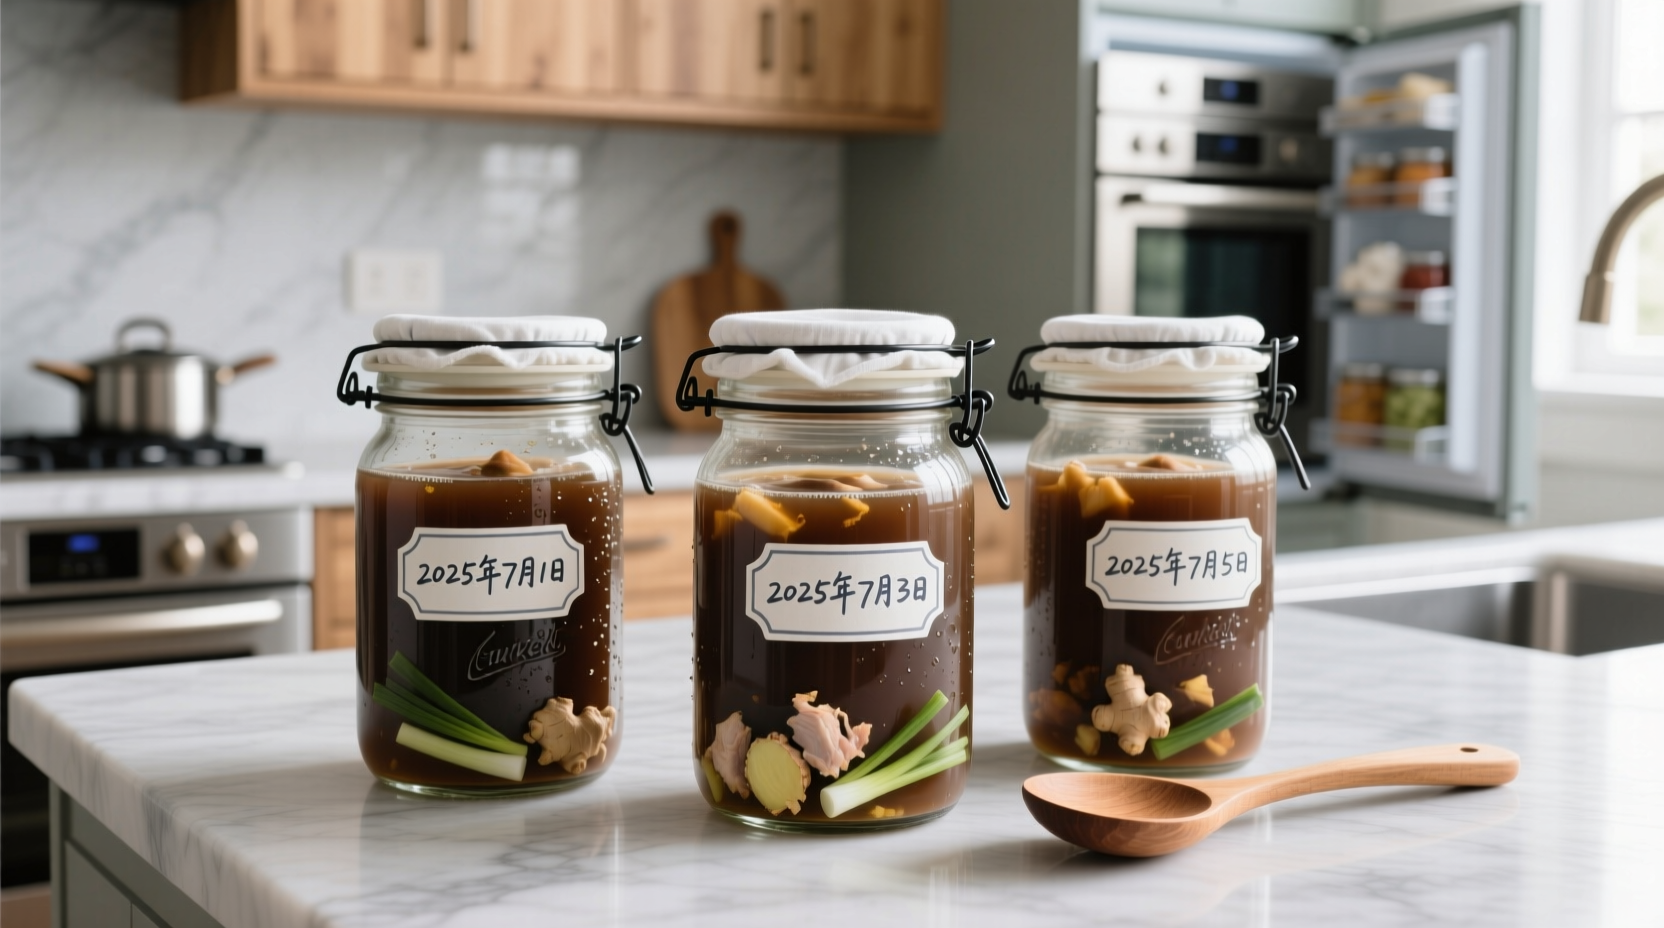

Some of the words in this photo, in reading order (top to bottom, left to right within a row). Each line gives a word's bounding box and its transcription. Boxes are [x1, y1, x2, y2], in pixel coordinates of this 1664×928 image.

[416, 554, 564, 596] 2025年7月1日
[1105, 547, 1248, 587] 2025年7月5日
[766, 570, 927, 616] 2025年7月3日
